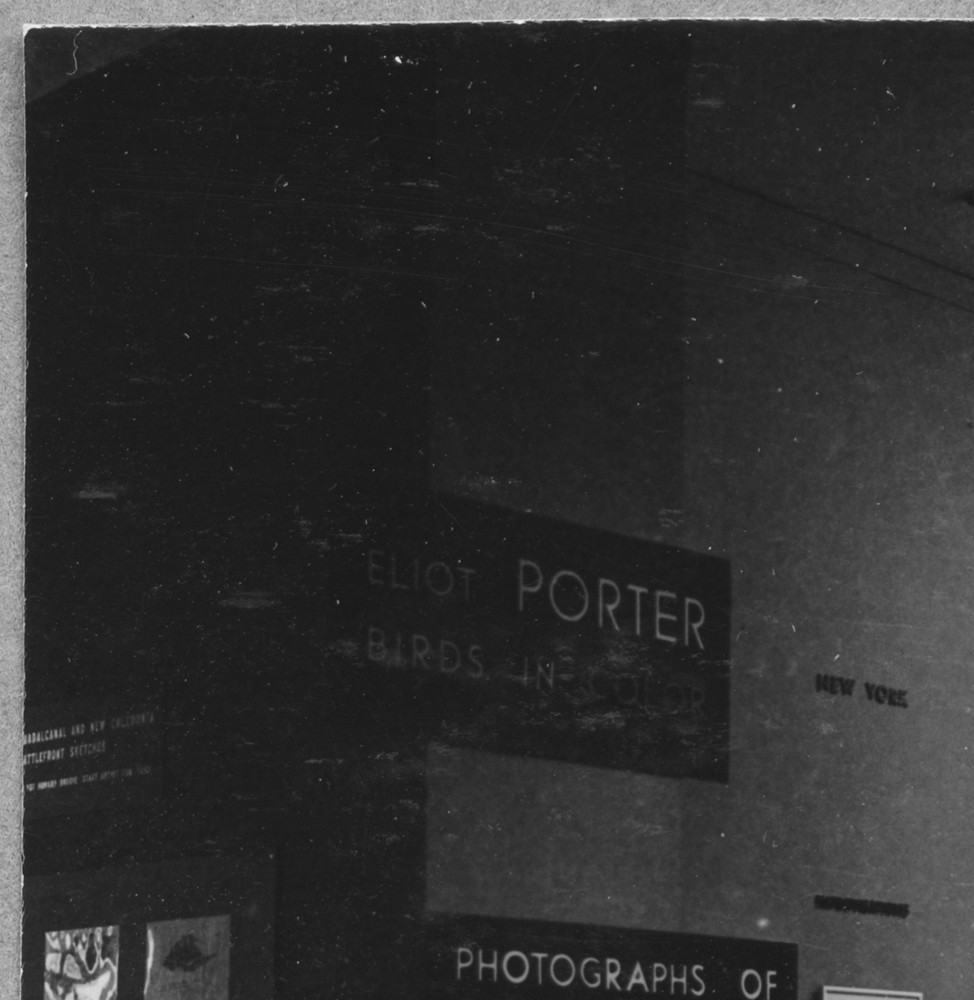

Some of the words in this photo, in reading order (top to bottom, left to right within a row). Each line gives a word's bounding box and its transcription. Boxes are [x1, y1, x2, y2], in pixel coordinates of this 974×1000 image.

[367, 548, 477, 601] ELIOT
[517, 558, 705, 649] PORTER
[366, 626, 485, 679] BIRDS
[523, 655, 555, 692] IN
[815, 673, 856, 696] NEW
[456, 947, 706, 997] PHOTOGRAPHS
[740, 968, 778, 1000] OF
